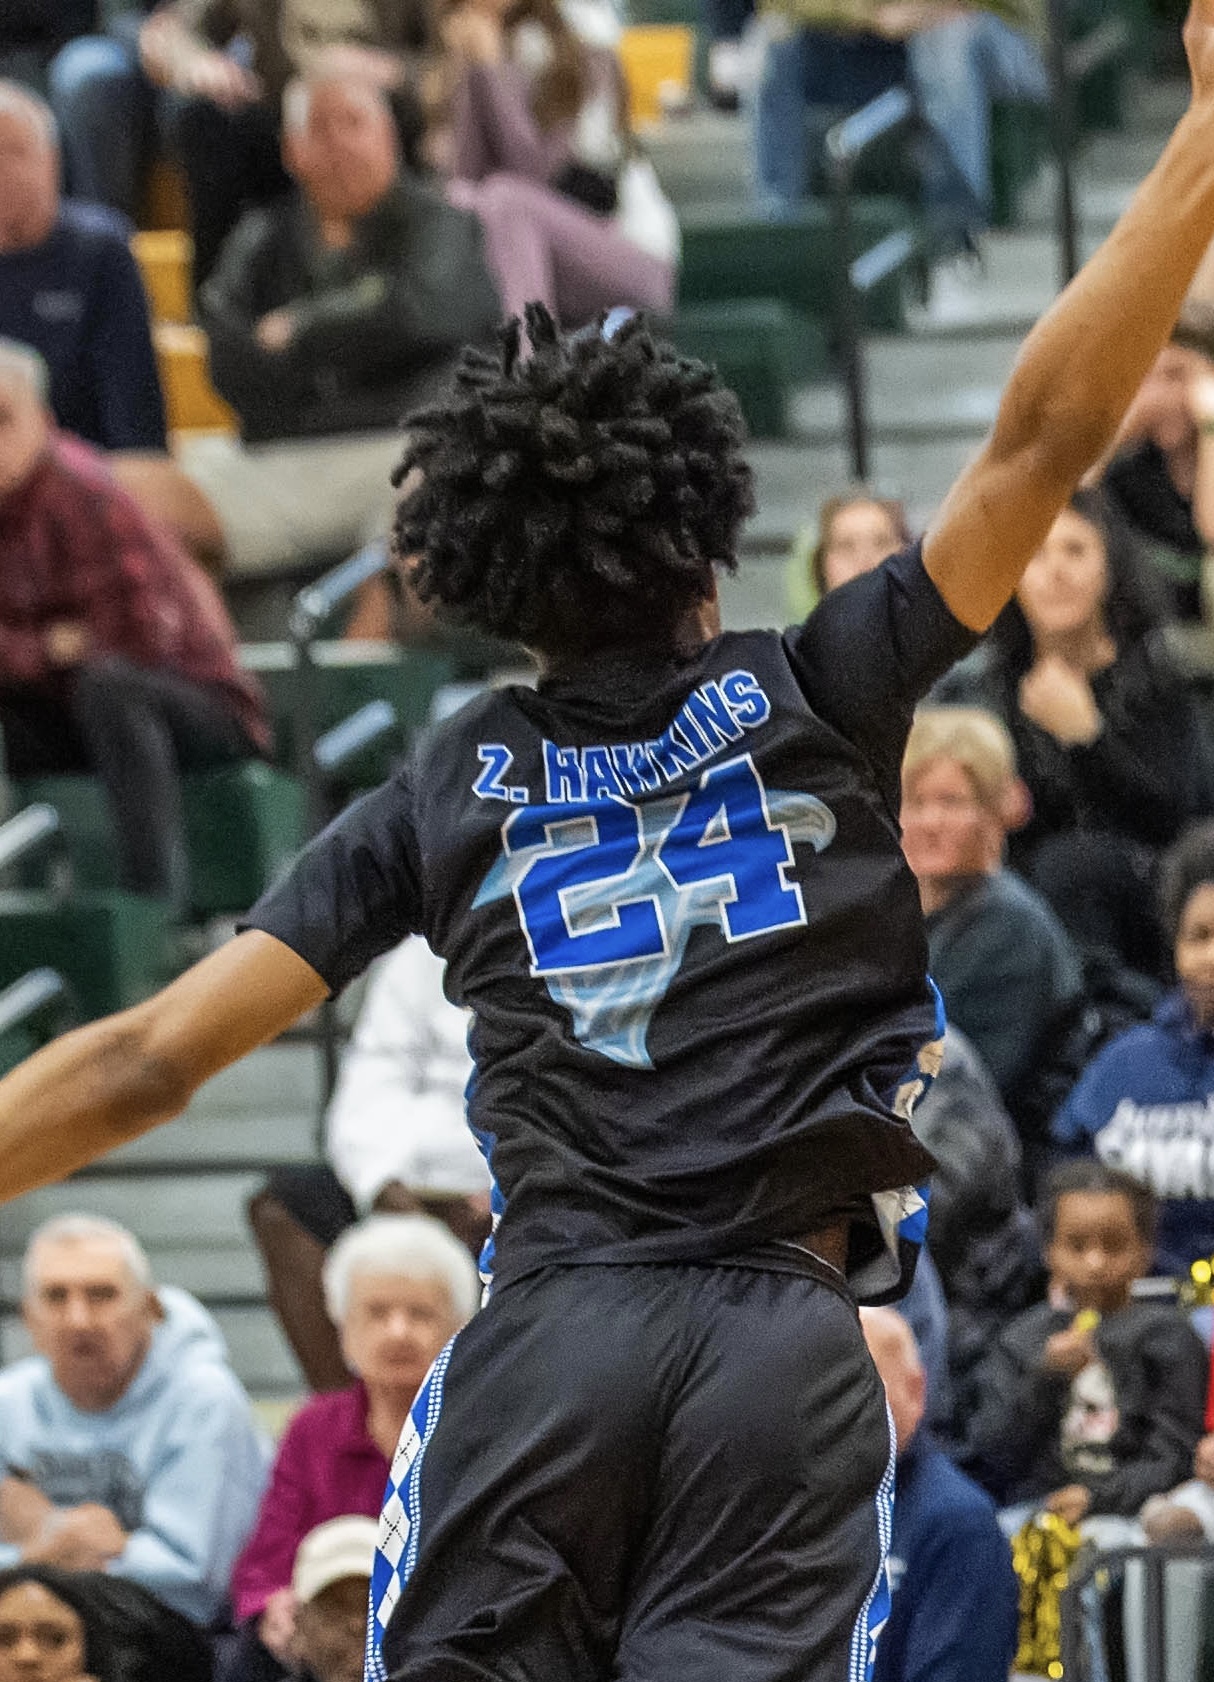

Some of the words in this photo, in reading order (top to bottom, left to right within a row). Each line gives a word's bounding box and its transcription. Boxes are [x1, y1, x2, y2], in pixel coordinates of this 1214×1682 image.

[471, 743, 529, 803] Z.
[542, 669, 771, 803] HAWKINS
[501, 752, 808, 978] 24
